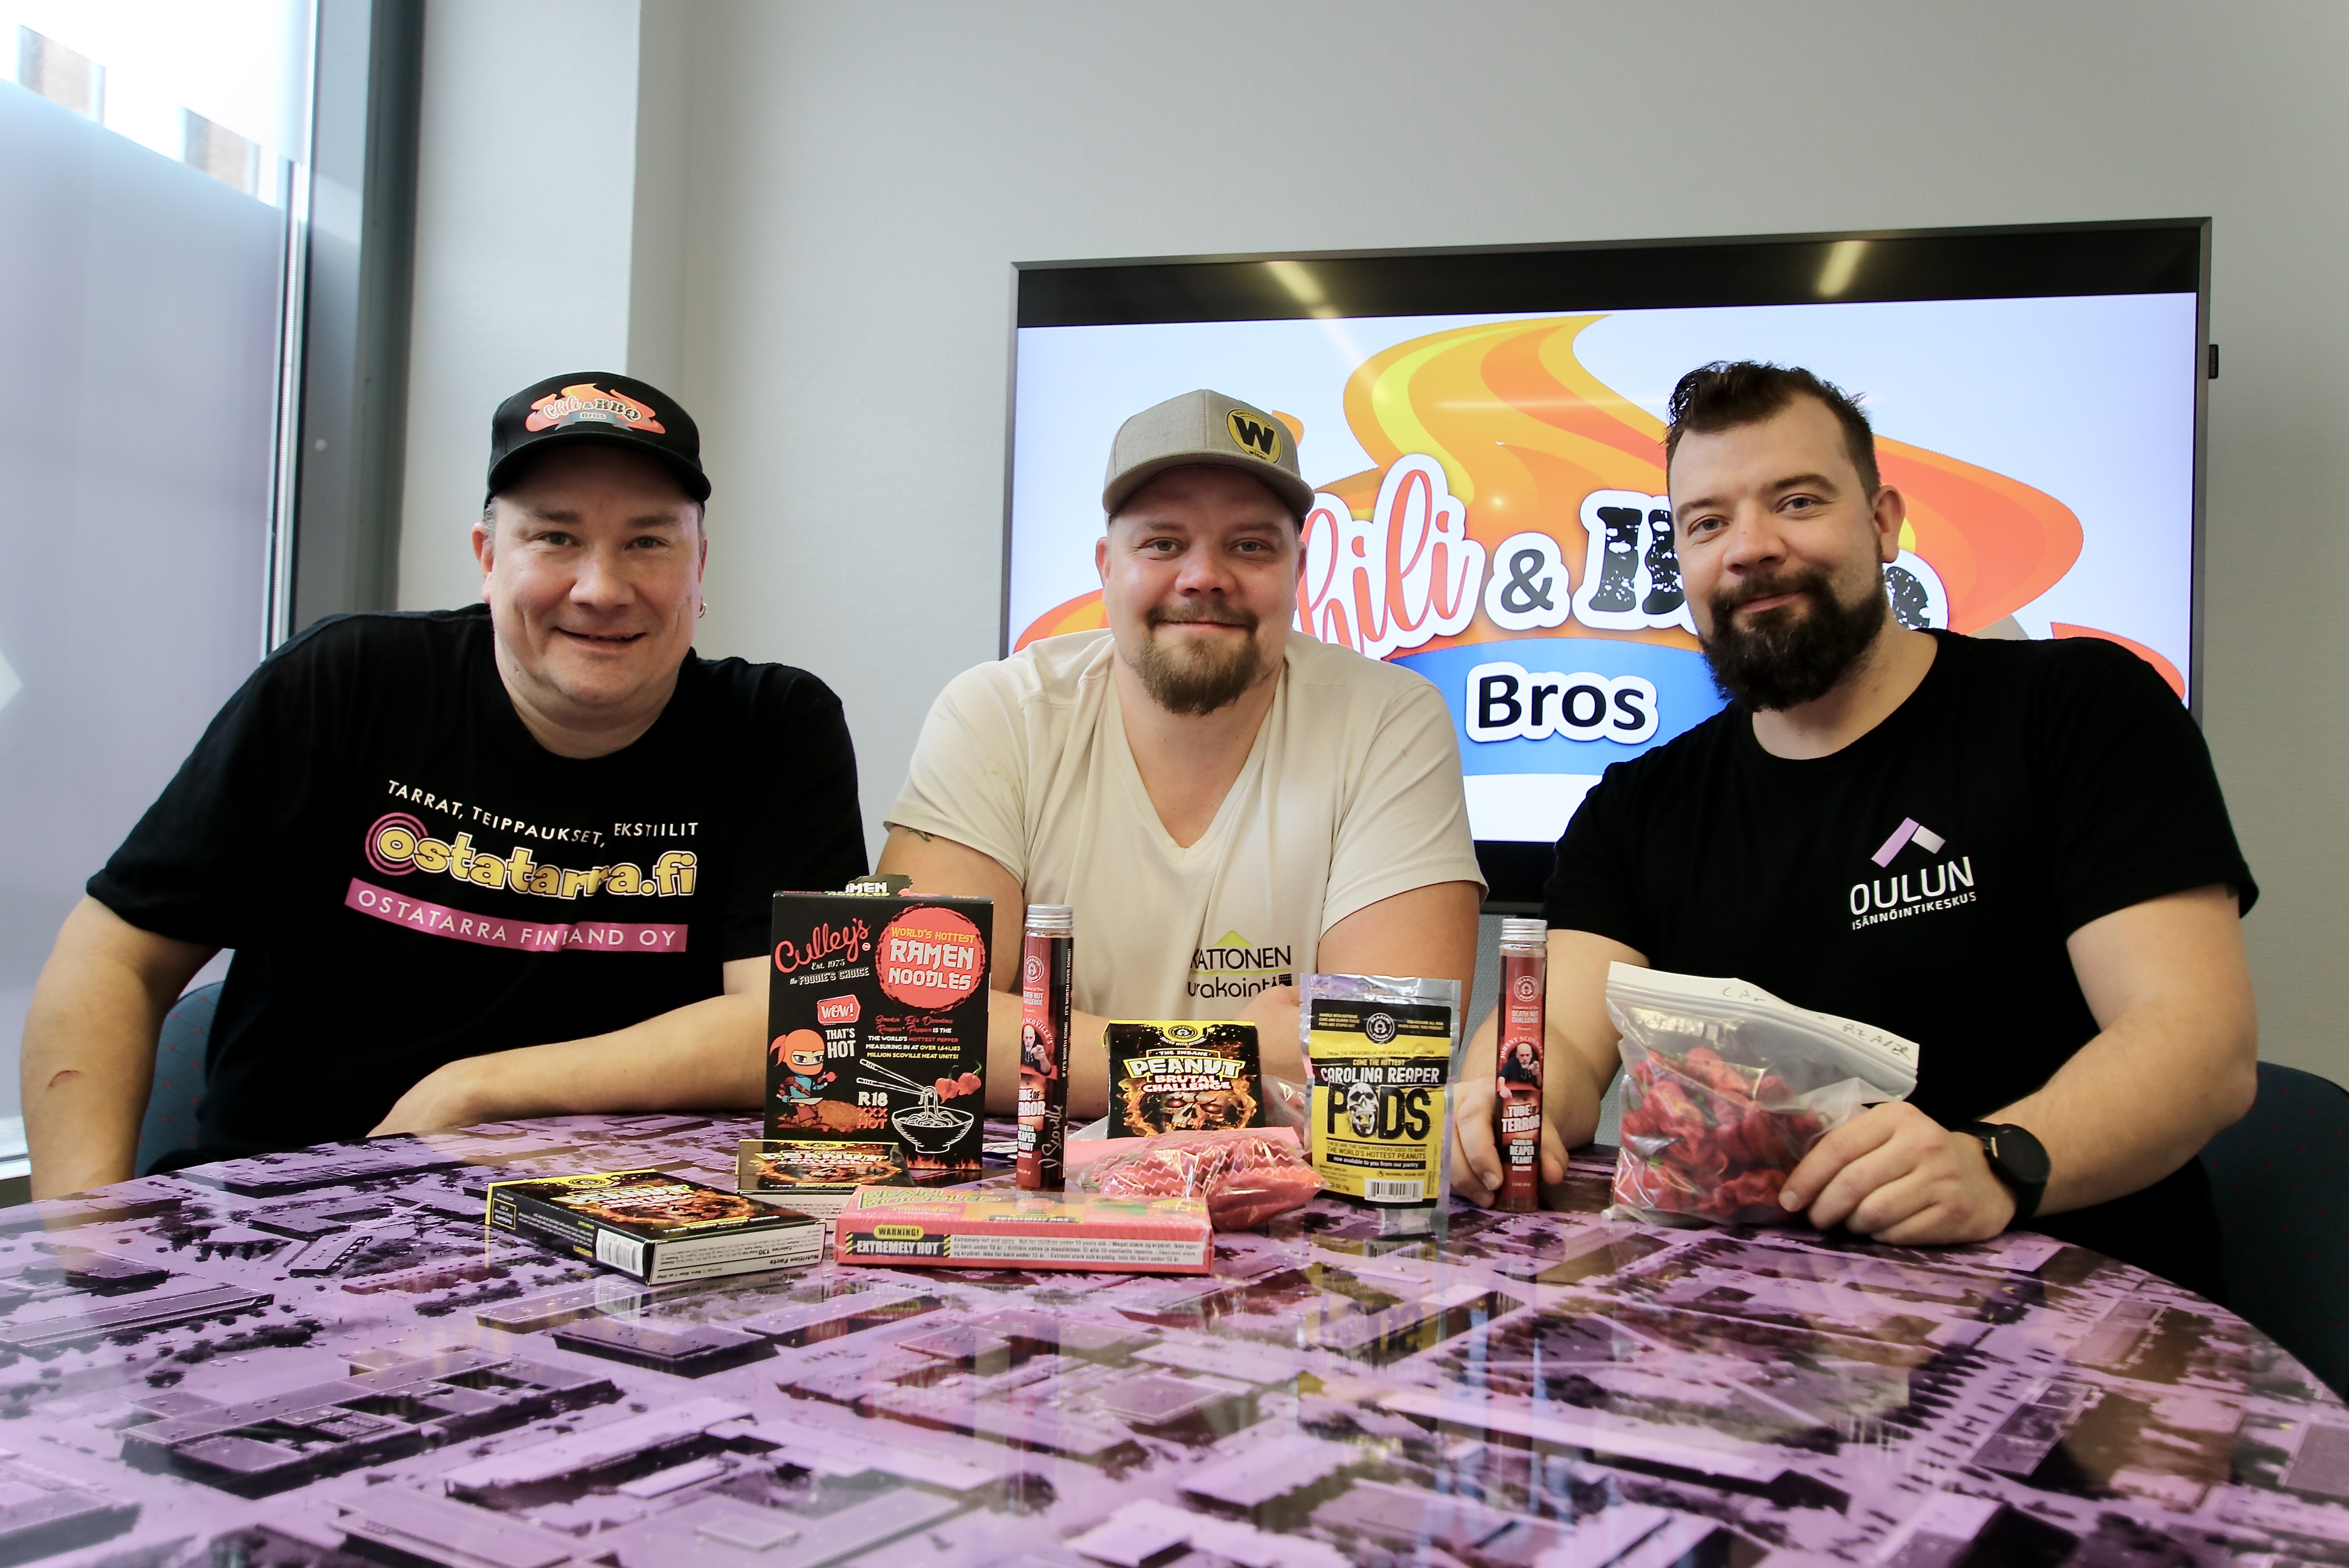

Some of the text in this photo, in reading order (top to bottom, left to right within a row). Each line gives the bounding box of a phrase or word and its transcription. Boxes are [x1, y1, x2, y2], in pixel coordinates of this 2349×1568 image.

[544, 396, 581, 419] Chili
[595, 399, 641, 421] BBQ
[1231, 415, 1274, 455] W
[1296, 469, 1470, 655] hili
[1501, 549, 1554, 613] &
[1479, 675, 1644, 730] Bros
[388, 780, 698, 848] TARRAT, TEIPPAUKSET, EKSTIILIT
[376, 827, 697, 899] ostatarra.fi
[845, 882, 887, 893] MEN
[1850, 856, 1974, 915] OULUN
[358, 890, 506, 942] OSTATARRA
[639, 929, 676, 946] OY
[1852, 892, 1977, 930] ISÄNNÖINTIKESKUS
[891, 926, 975, 944] WORLD'S HOTTEST
[774, 918, 871, 973] Culley's
[890, 938, 974, 971] RAMEN
[811, 959, 845, 970] Est. 1975
[798, 972, 836, 986] FOODIE'S
[838, 967, 870, 979] CHOICE
[888, 967, 971, 991] NOODLES
[821, 1003, 854, 1019] WOW!
[825, 1028, 856, 1040] THAT'S
[827, 1040, 856, 1059] HOT
[1127, 1057, 1241, 1077] PEANUT
[1320, 1066, 1440, 1083] CAROLINA REAPER
[1142, 1081, 1232, 1093] CHALLENGE
[1154, 1074, 1219, 1083] BRUTAL
[857, 1091, 888, 1106] R18
[1507, 1104, 1531, 1118] TUBE
[858, 1117, 887, 1130] HOT
[1501, 1114, 1540, 1133] TERROR
[1339, 1147, 1365, 1157] WORLD'S
[878, 1227, 919, 1237] WARNING!
[856, 1240, 939, 1255] EXTREMELY HOT
[790, 1254, 819, 1264] Nutrition
